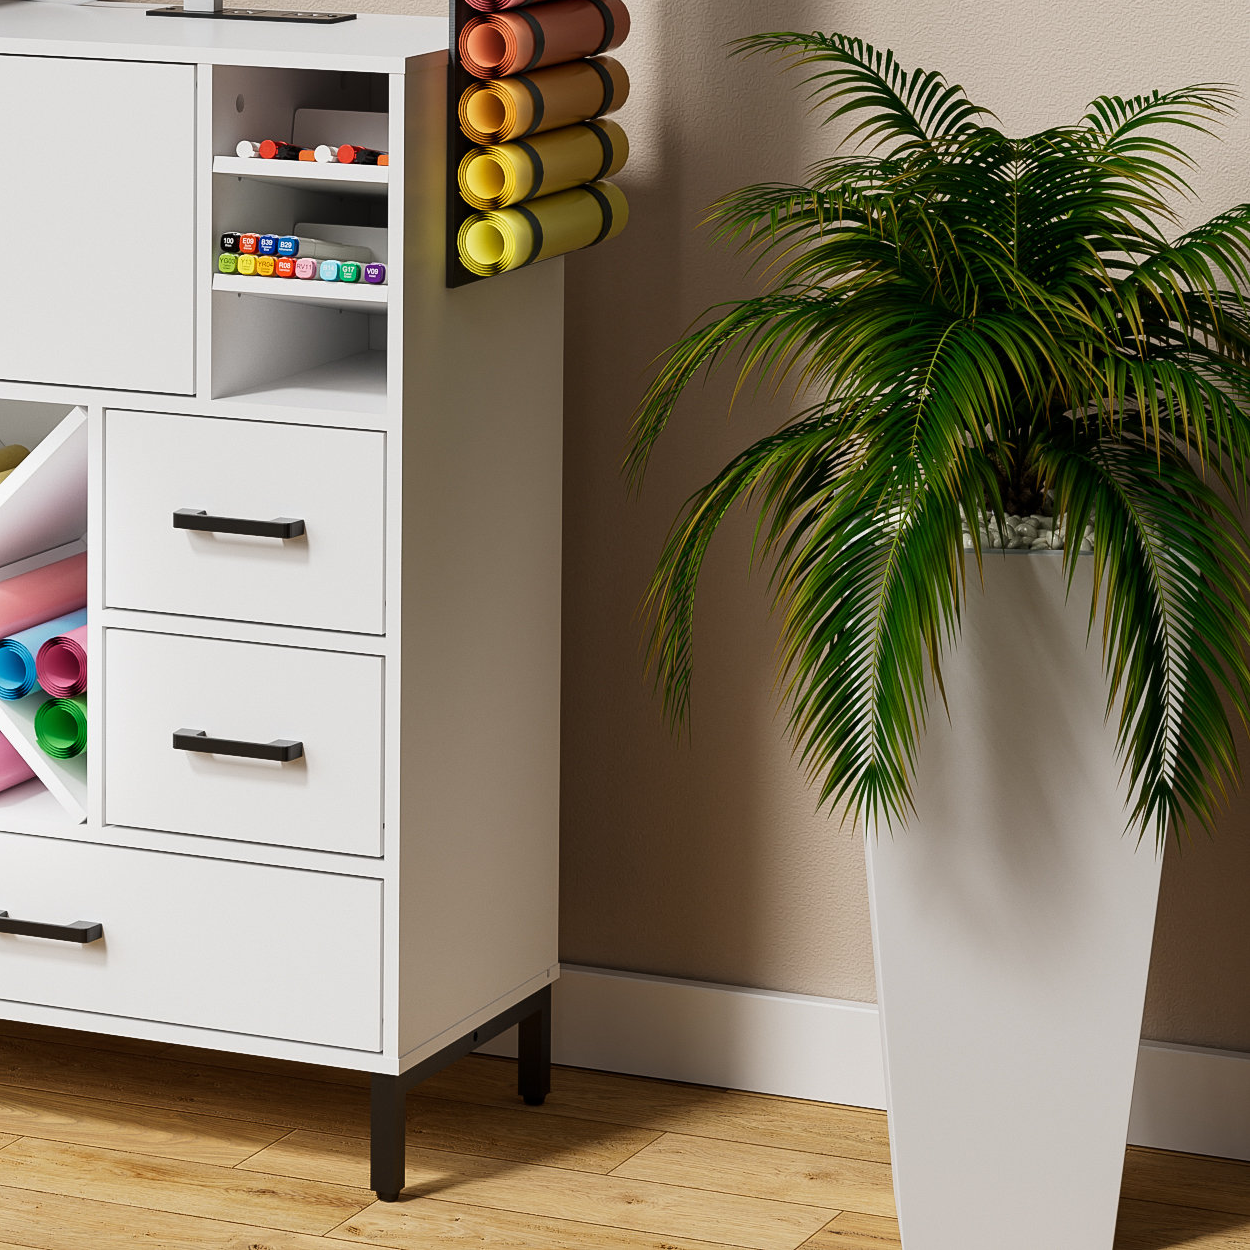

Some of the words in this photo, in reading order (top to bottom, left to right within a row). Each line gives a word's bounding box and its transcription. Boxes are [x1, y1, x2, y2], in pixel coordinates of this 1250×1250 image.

[223, 237, 234, 245] 100
[242, 237, 255, 245] E09
[280, 241, 293, 249] B29
[366, 267, 379, 275] V09
